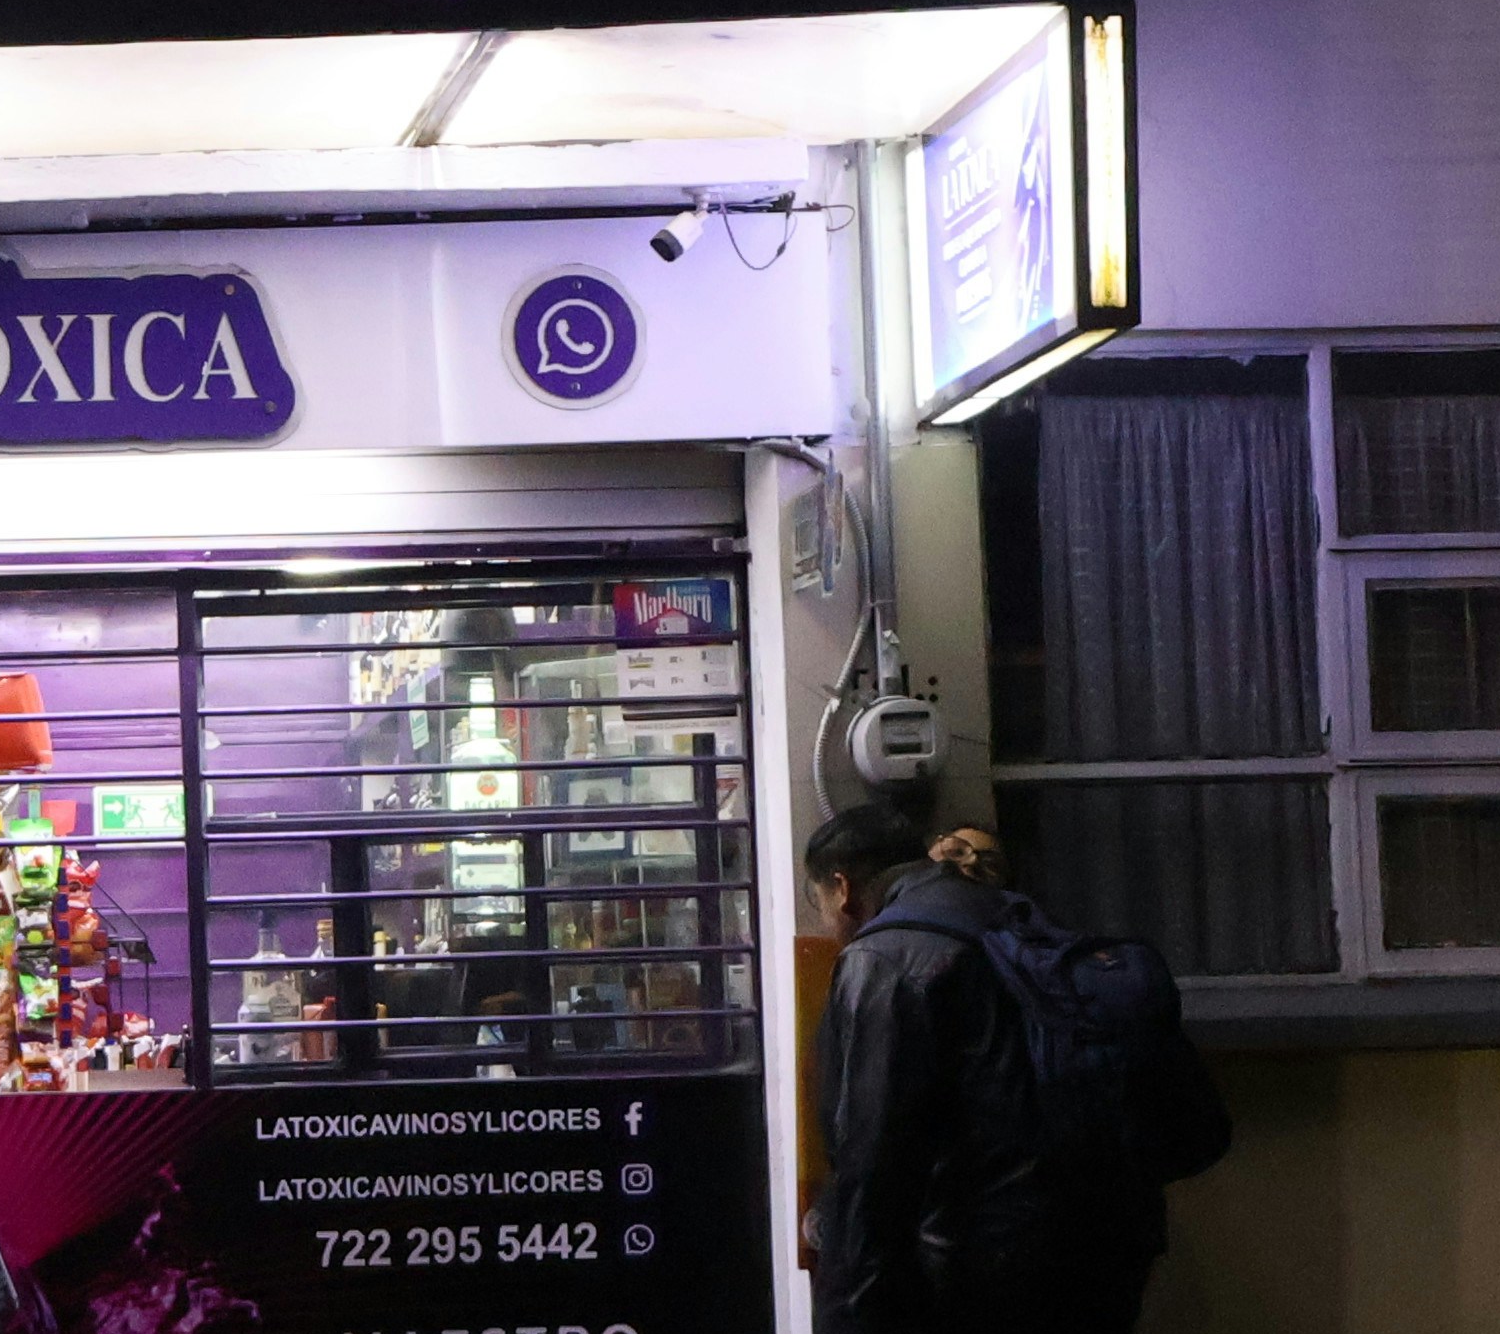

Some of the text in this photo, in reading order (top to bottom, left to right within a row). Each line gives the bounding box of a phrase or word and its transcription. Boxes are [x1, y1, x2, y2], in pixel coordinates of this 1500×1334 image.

[633, 585, 713, 626] Marlboro
[255, 1107, 601, 1140] LATOXICAVINOSYLICORES
[258, 1169, 604, 1202] LATOXICAVINOSYLICORES
[315, 1221, 599, 1268] 722 295 5442
